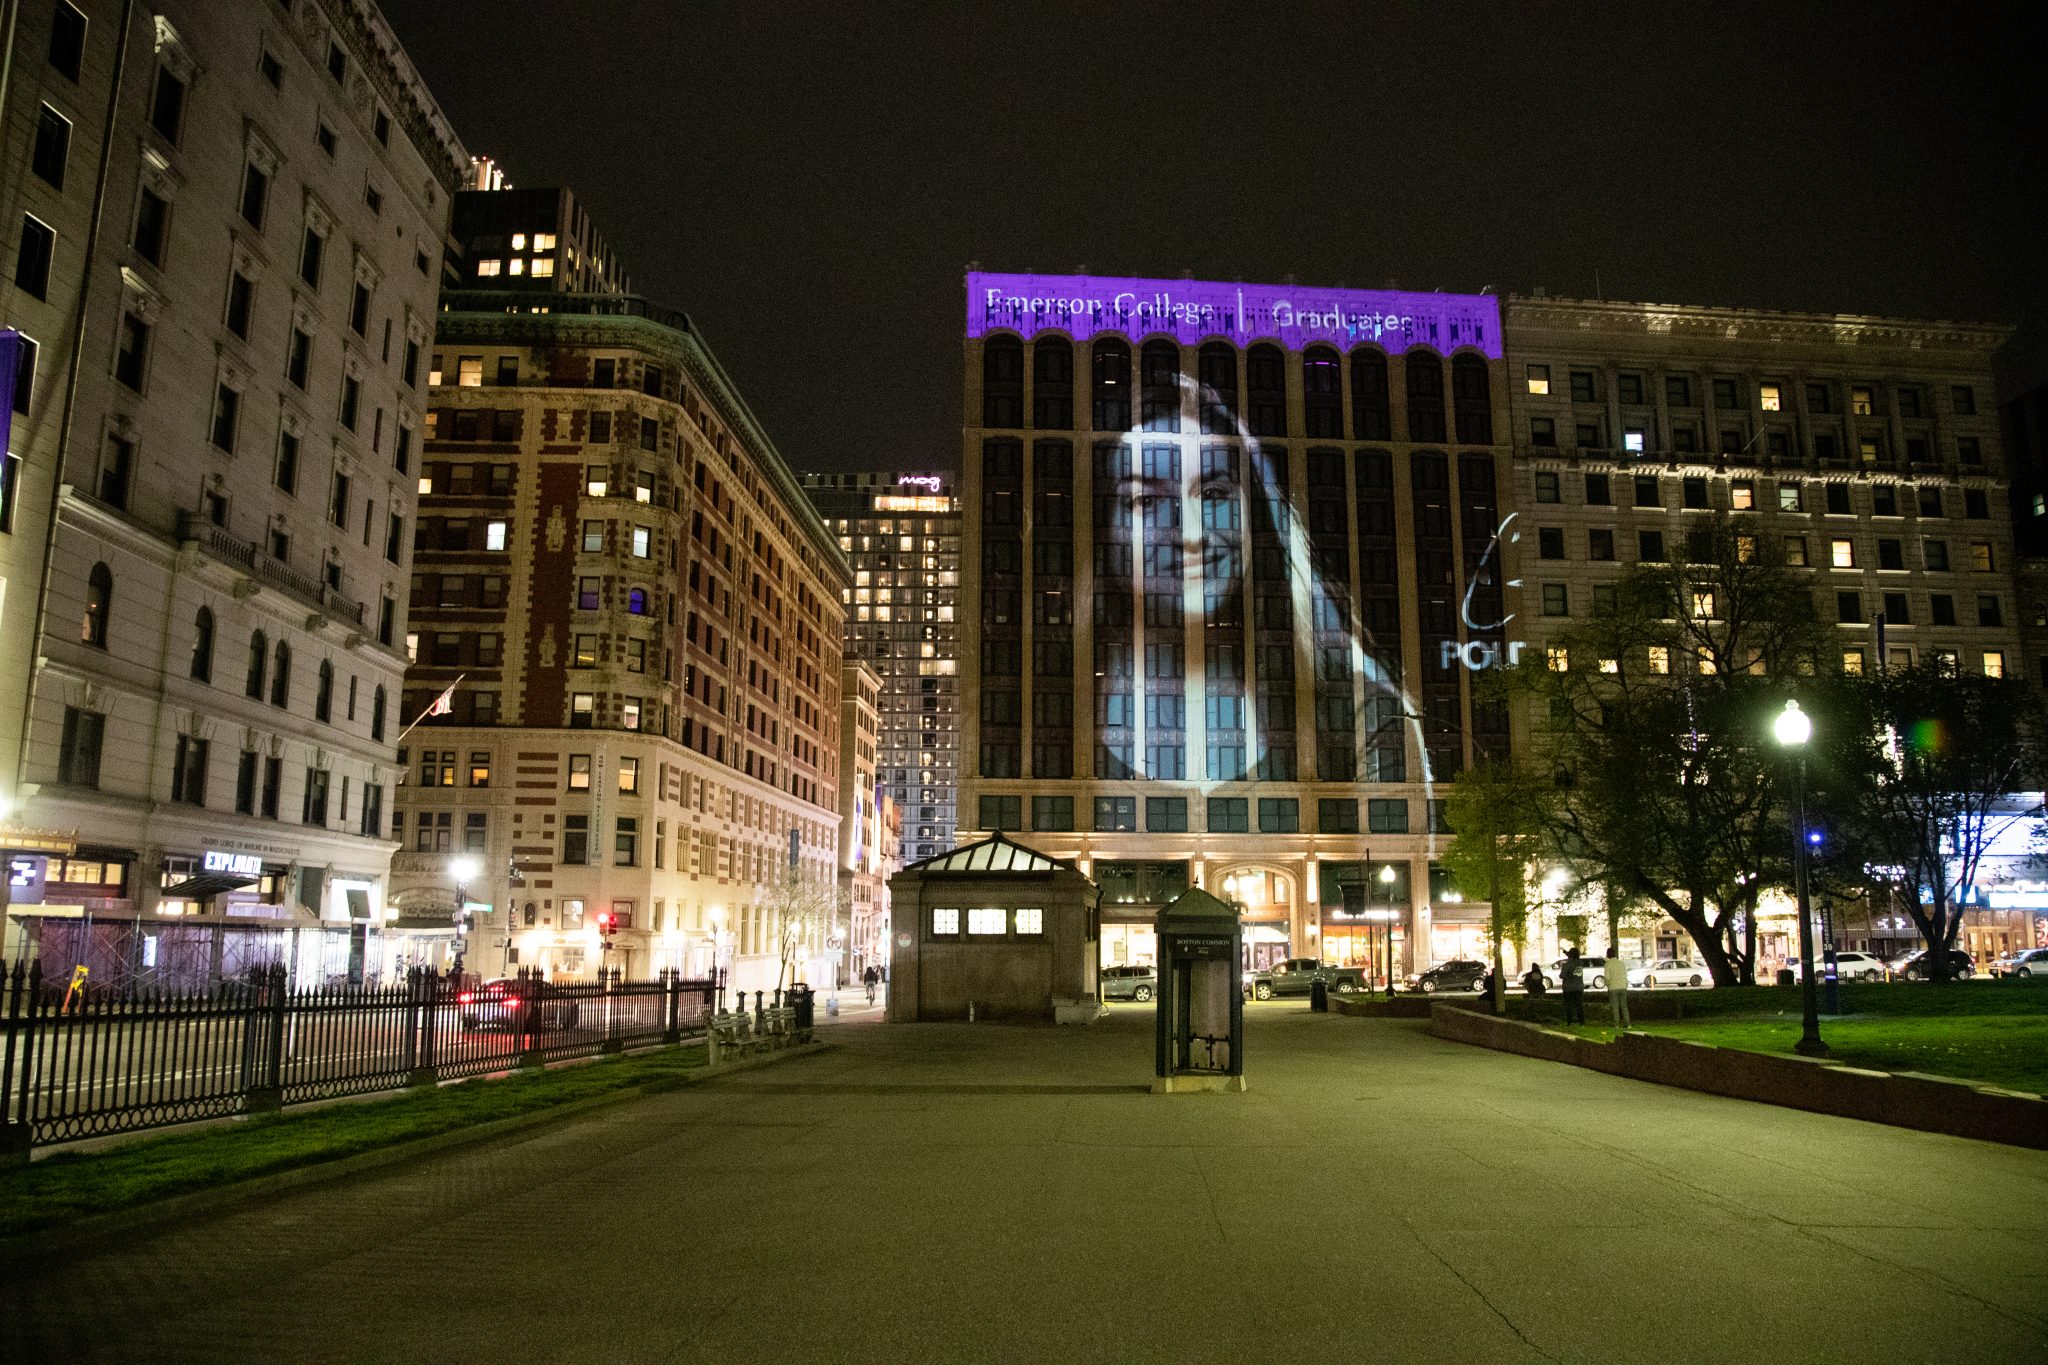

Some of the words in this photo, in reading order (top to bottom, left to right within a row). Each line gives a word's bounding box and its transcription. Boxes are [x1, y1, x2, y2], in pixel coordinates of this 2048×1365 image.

[984, 288, 1103, 315] Emerson
[1114, 292, 1214, 325] College
[1272, 301, 1413, 332] Graduates
[1823, 943, 1833, 951] 39
